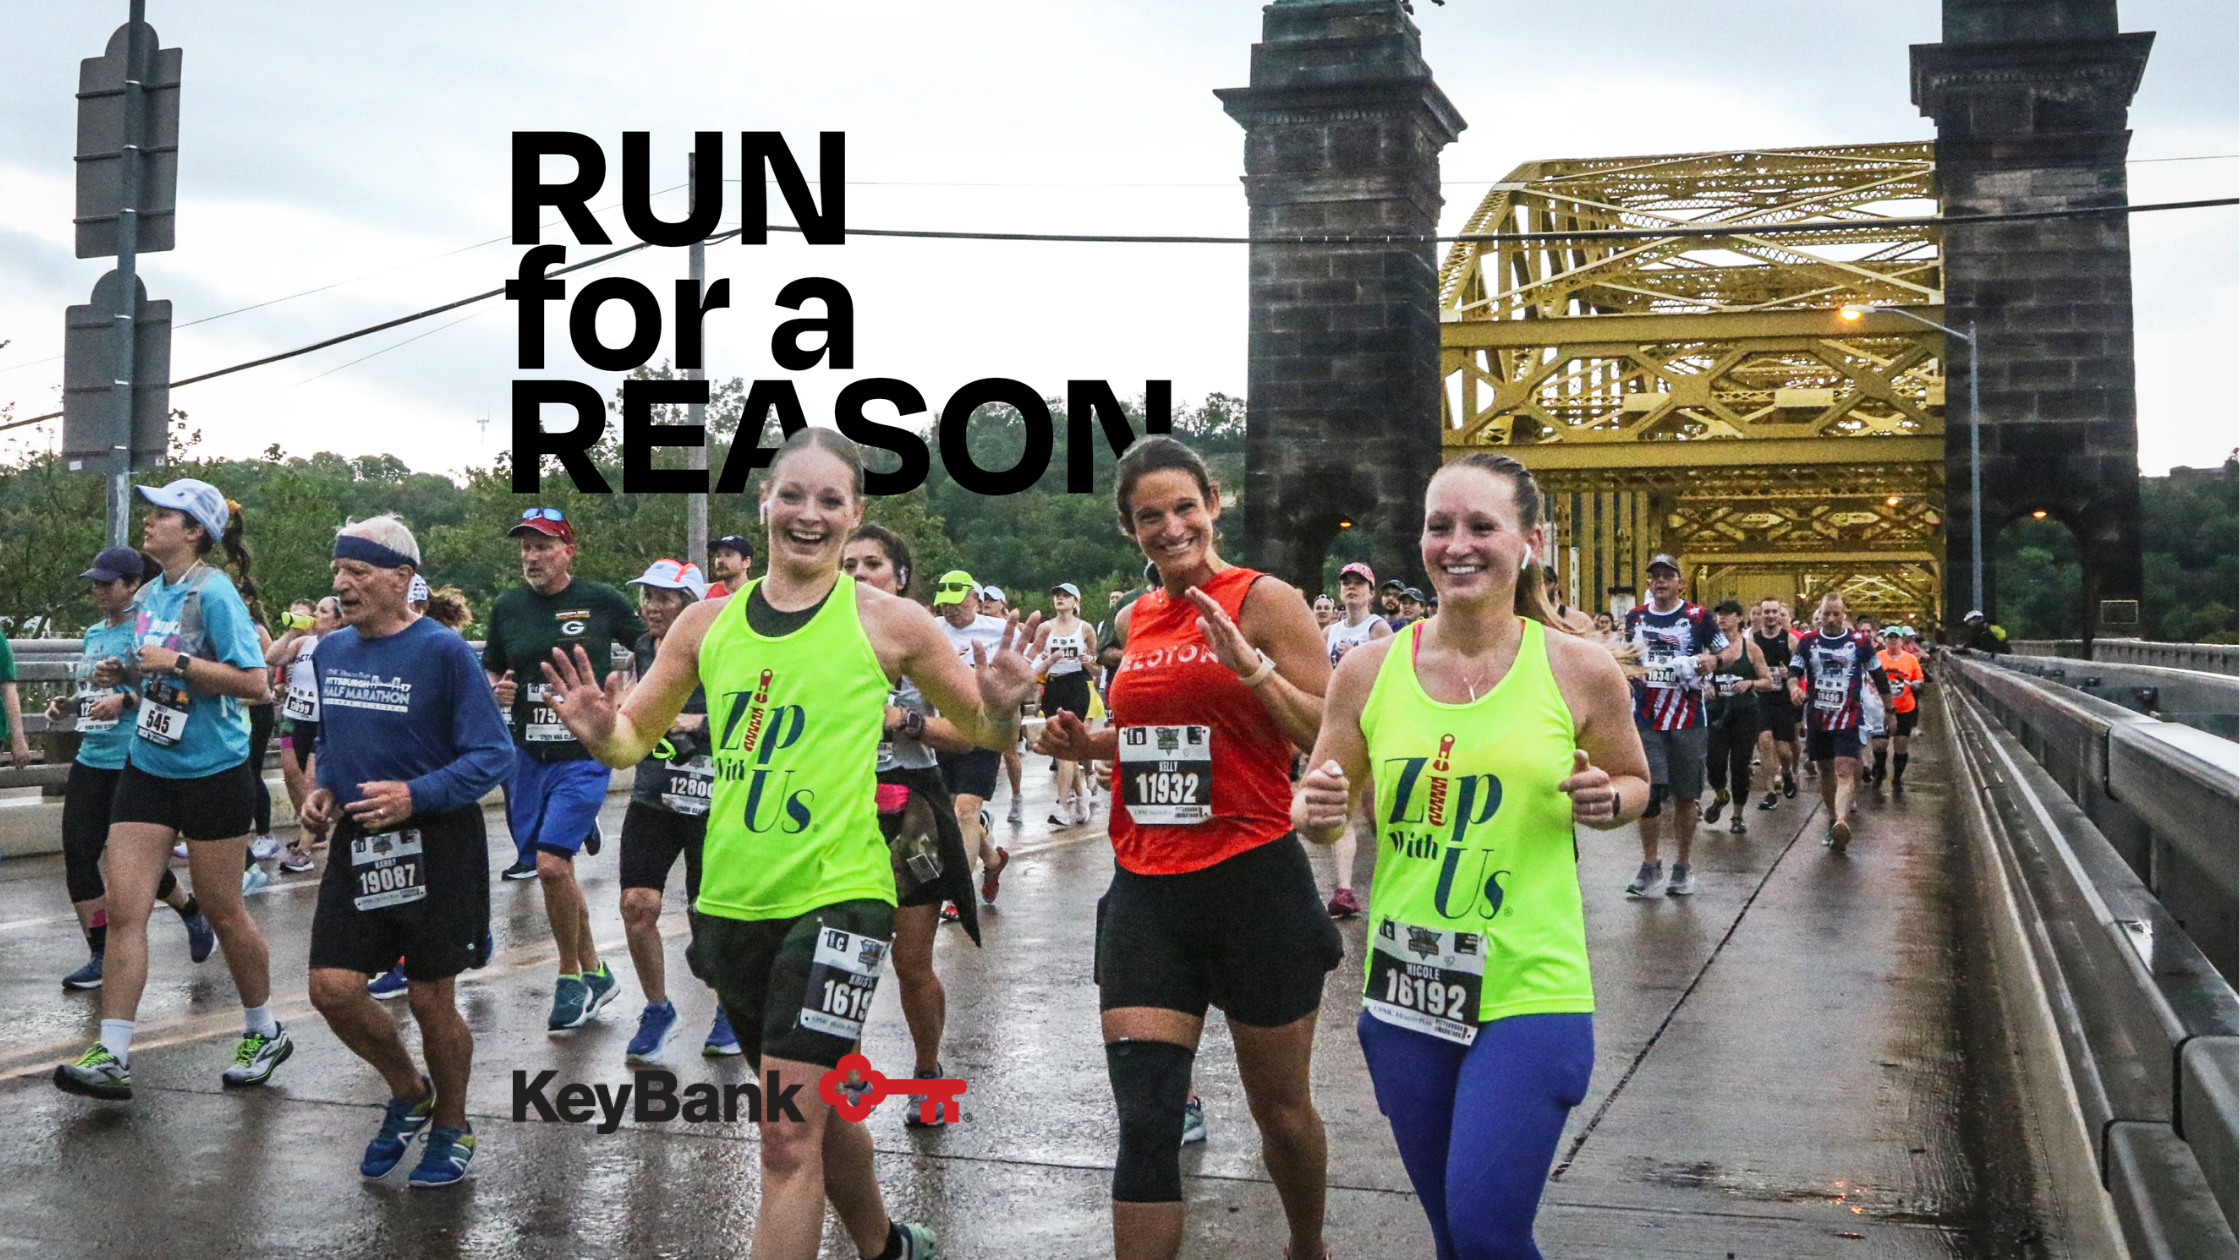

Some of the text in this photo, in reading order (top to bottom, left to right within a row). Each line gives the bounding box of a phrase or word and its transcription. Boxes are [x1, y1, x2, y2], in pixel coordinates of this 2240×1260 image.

[562, 621, 584, 635] G
[1120, 643, 1219, 672] ELOTON
[323, 686, 344, 698] HALF
[345, 687, 411, 705] MARATHON
[146, 710, 171, 734] 545
[533, 708, 563, 724] 175
[720, 668, 806, 765] Zip
[1159, 761, 1178, 772] KELLY
[743, 769, 815, 834] Us
[1136, 772, 1199, 804] 11932
[1384, 734, 1503, 842] Zip
[1388, 831, 1439, 860] With
[360, 863, 416, 895] 19087
[1434, 847, 1511, 920] Us
[836, 937, 845, 951] C
[1406, 962, 1440, 981] NICOLE
[1386, 967, 1467, 1021] 16192
